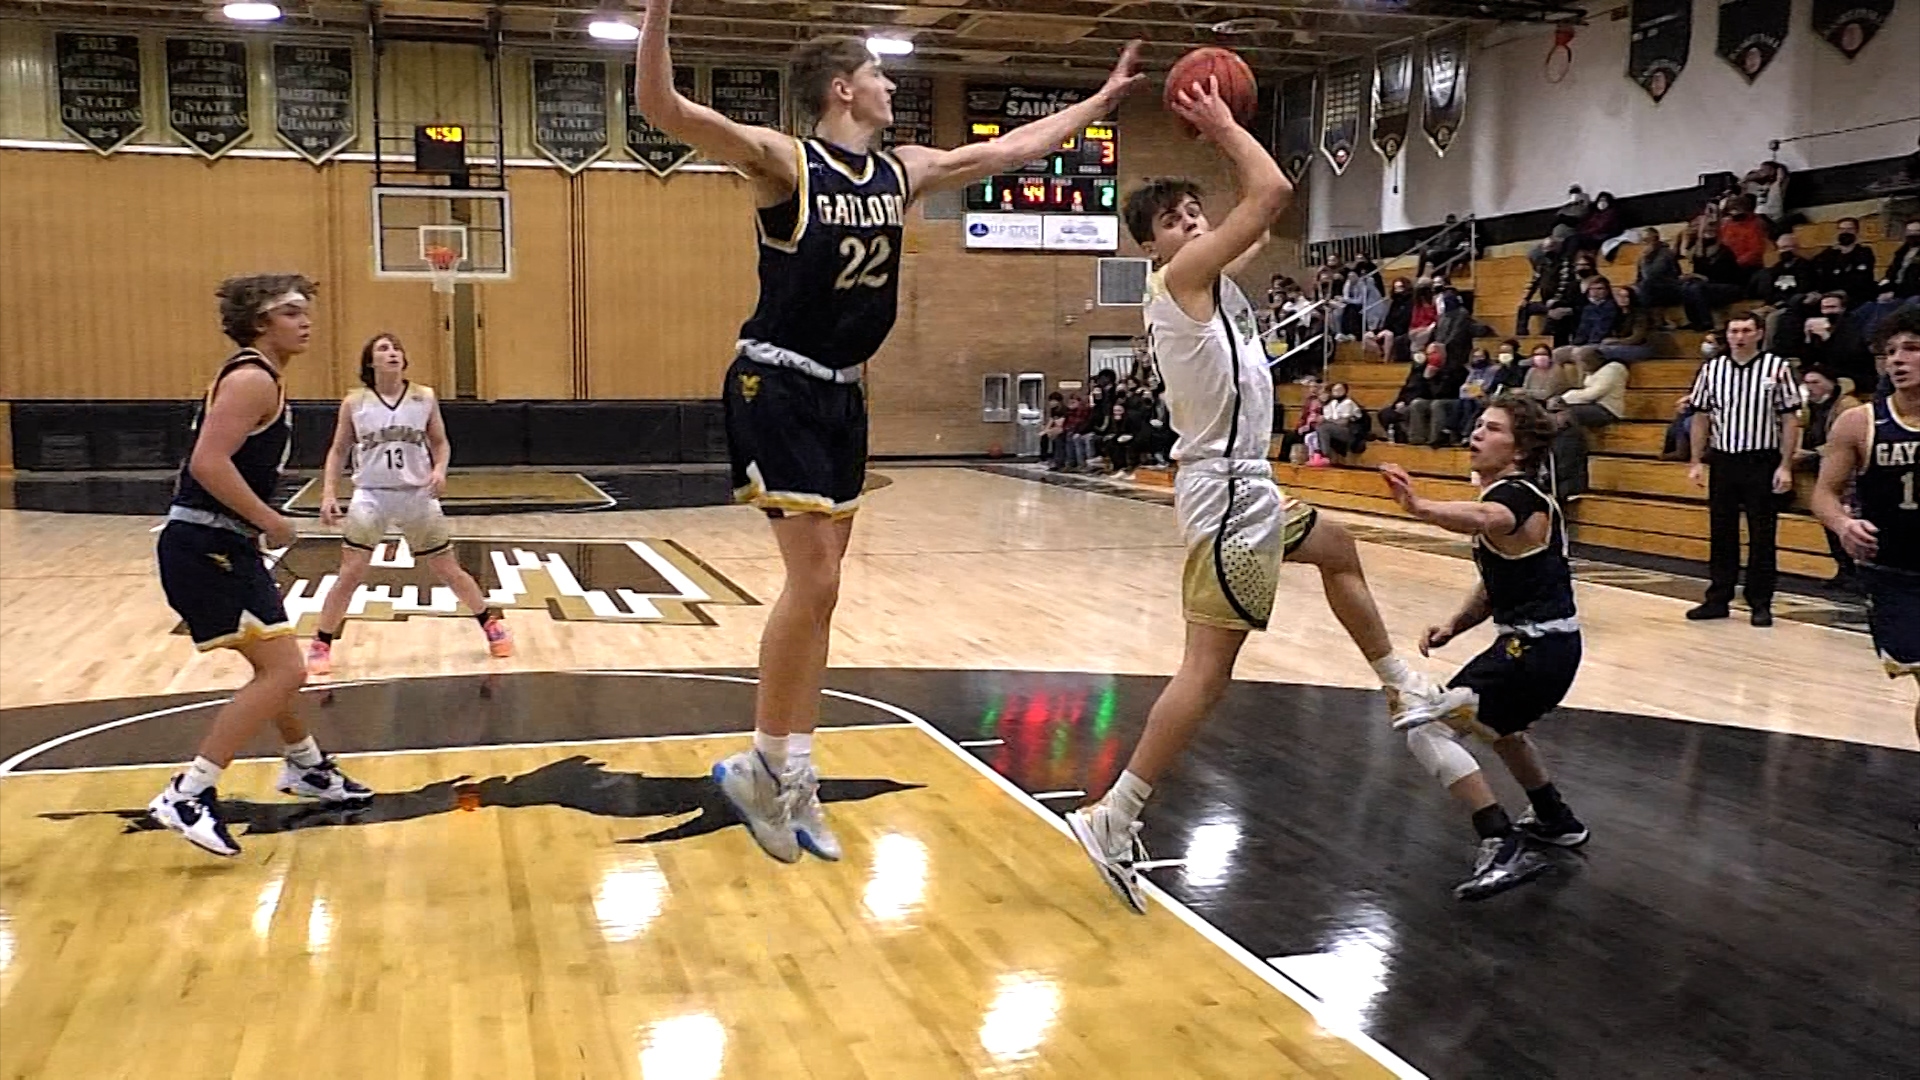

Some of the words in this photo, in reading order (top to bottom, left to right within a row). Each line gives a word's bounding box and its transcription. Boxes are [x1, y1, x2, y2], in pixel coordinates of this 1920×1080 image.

[76, 95, 123, 108] STATE
[184, 101, 232, 113] STATE
[62, 104, 142, 122] CHAMPIONS
[171, 109, 248, 127] CHAMPIONS
[288, 104, 335, 118] STATE
[278, 113, 353, 132] CHAMPIONS
[551, 117, 591, 128] STATE
[538, 127, 606, 142] CHAMPIONS
[1101, 141, 1114, 163] 3
[1023, 185, 1044, 202] 44
[1102, 187, 1114, 206] 2
[833, 235, 891, 290] 22
[384, 447, 404, 470] 13
[1876, 441, 1920, 466] GAY
